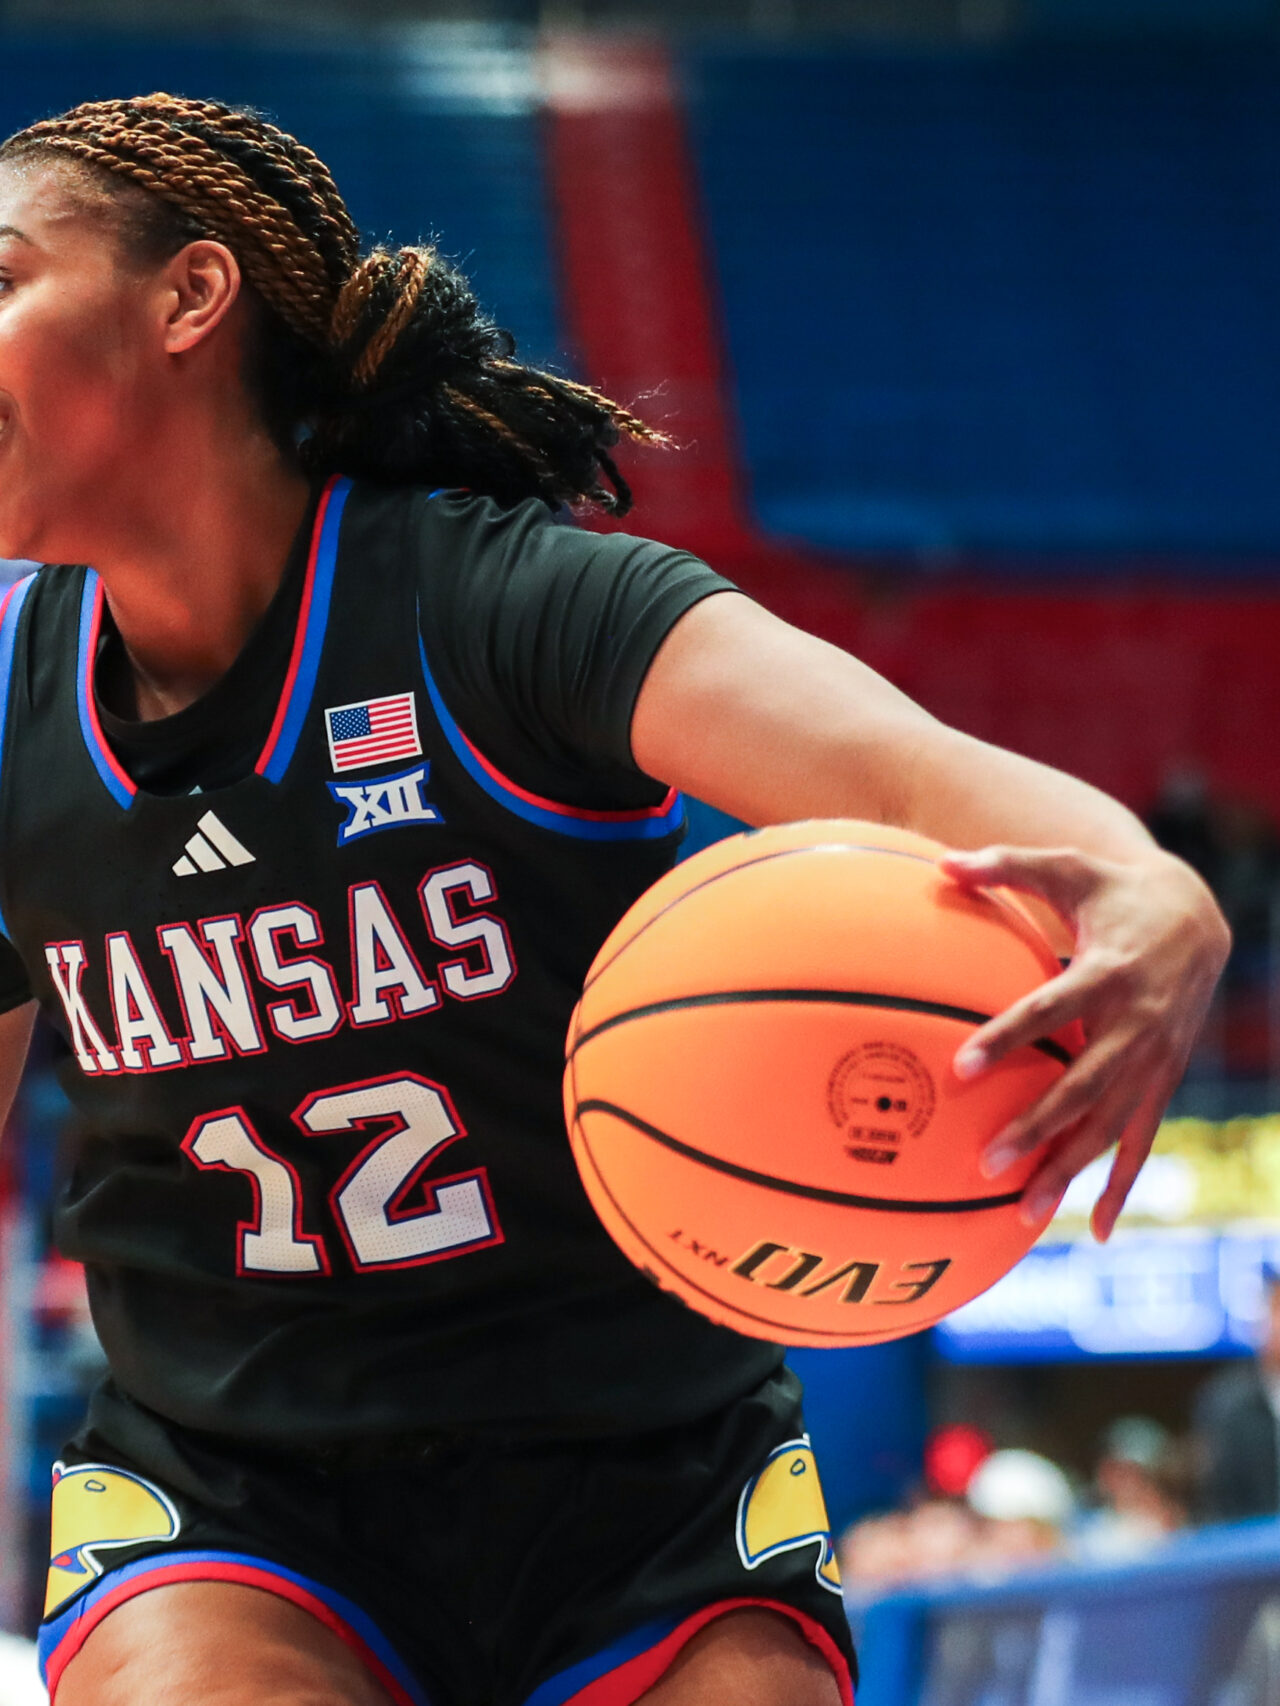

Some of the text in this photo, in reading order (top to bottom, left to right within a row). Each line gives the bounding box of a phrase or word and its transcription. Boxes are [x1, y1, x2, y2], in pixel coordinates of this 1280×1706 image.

[327, 762, 444, 846] XII
[45, 858, 517, 1076] KANSAS
[181, 1071, 505, 1277] 12
[668, 1229, 729, 1267] NXT
[729, 1240, 953, 1305] EVO
